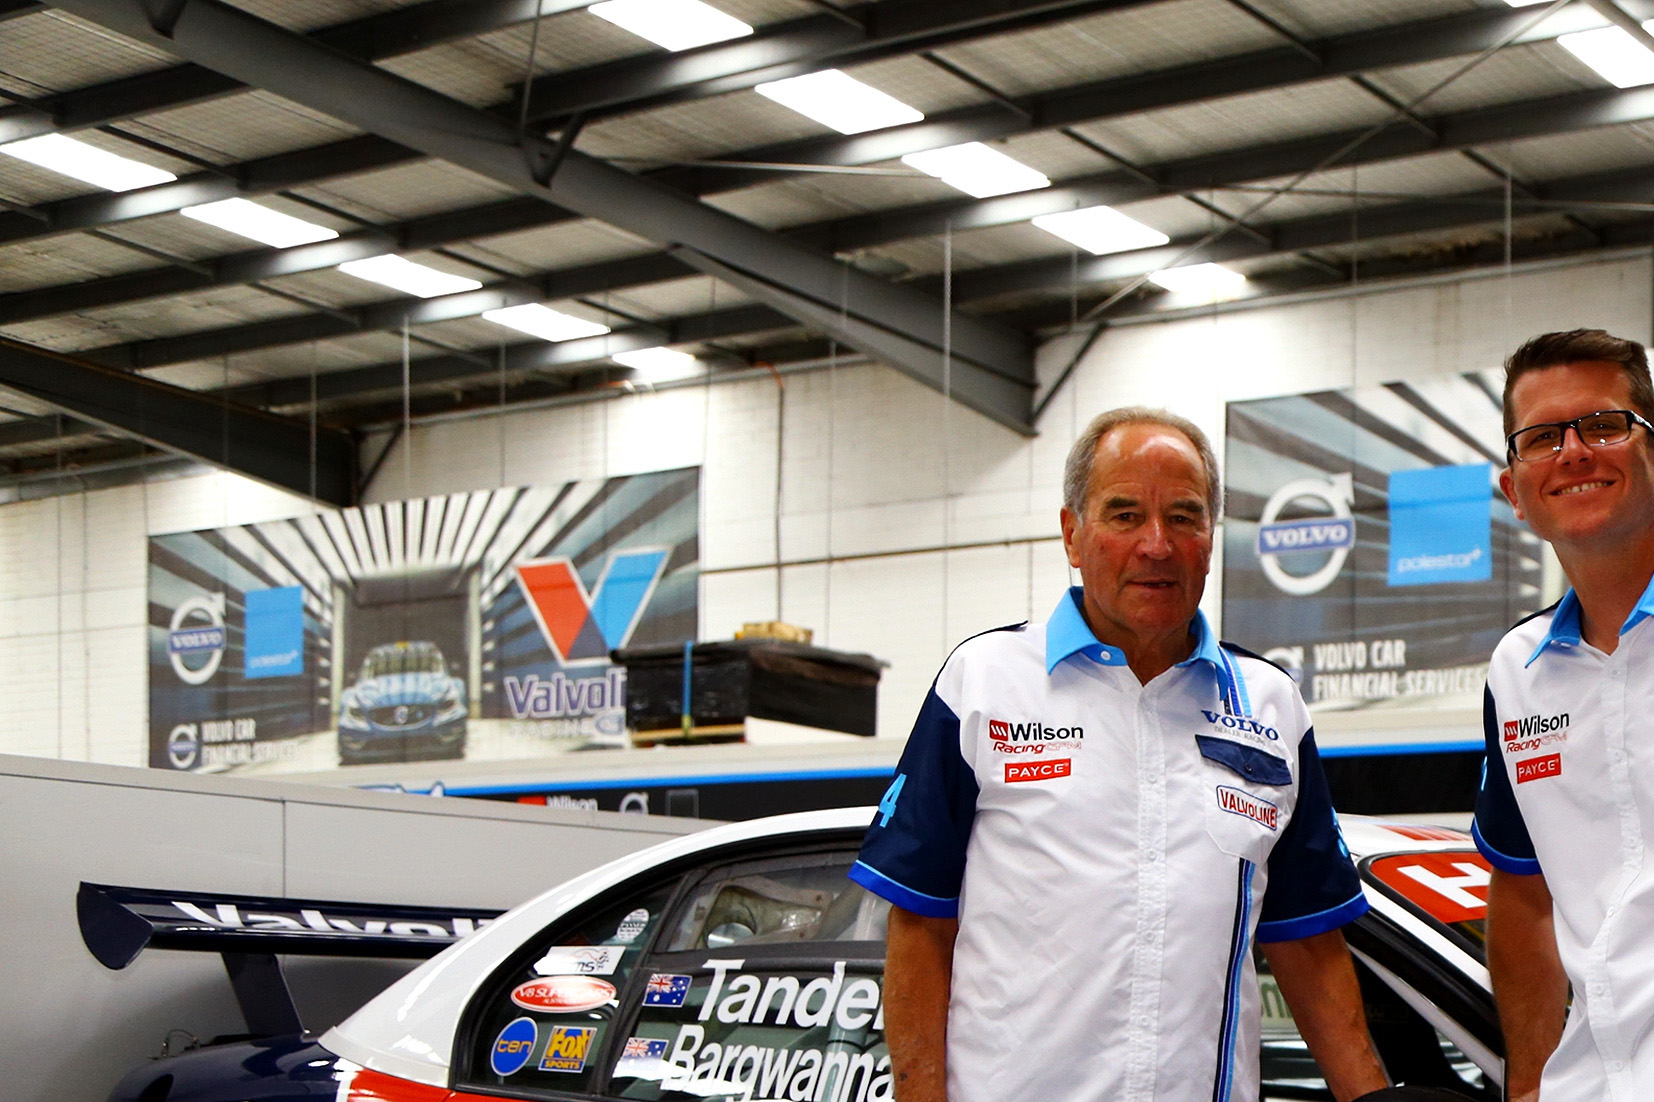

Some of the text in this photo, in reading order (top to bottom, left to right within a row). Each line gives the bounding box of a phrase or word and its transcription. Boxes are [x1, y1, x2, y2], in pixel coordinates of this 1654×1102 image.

[1263, 524, 1349, 549] VOLVO
[1312, 638, 1407, 671] VOLVO CAR
[1311, 670, 1399, 701] FINANCIAL
[1008, 722, 1084, 742] Wilson
[1200, 709, 1279, 742] VOLVO
[1518, 712, 1570, 739] Wilson
[992, 741, 1047, 755] Racing
[1505, 737, 1541, 754] Racing
[1008, 763, 1065, 779] PAYCE
[1517, 762, 1556, 778] PAYCE
[1219, 788, 1278, 828] VALVOLINE
[496, 1038, 533, 1054] ten
[546, 1027, 590, 1059] FOX
[544, 1060, 581, 1070] SPORTS
